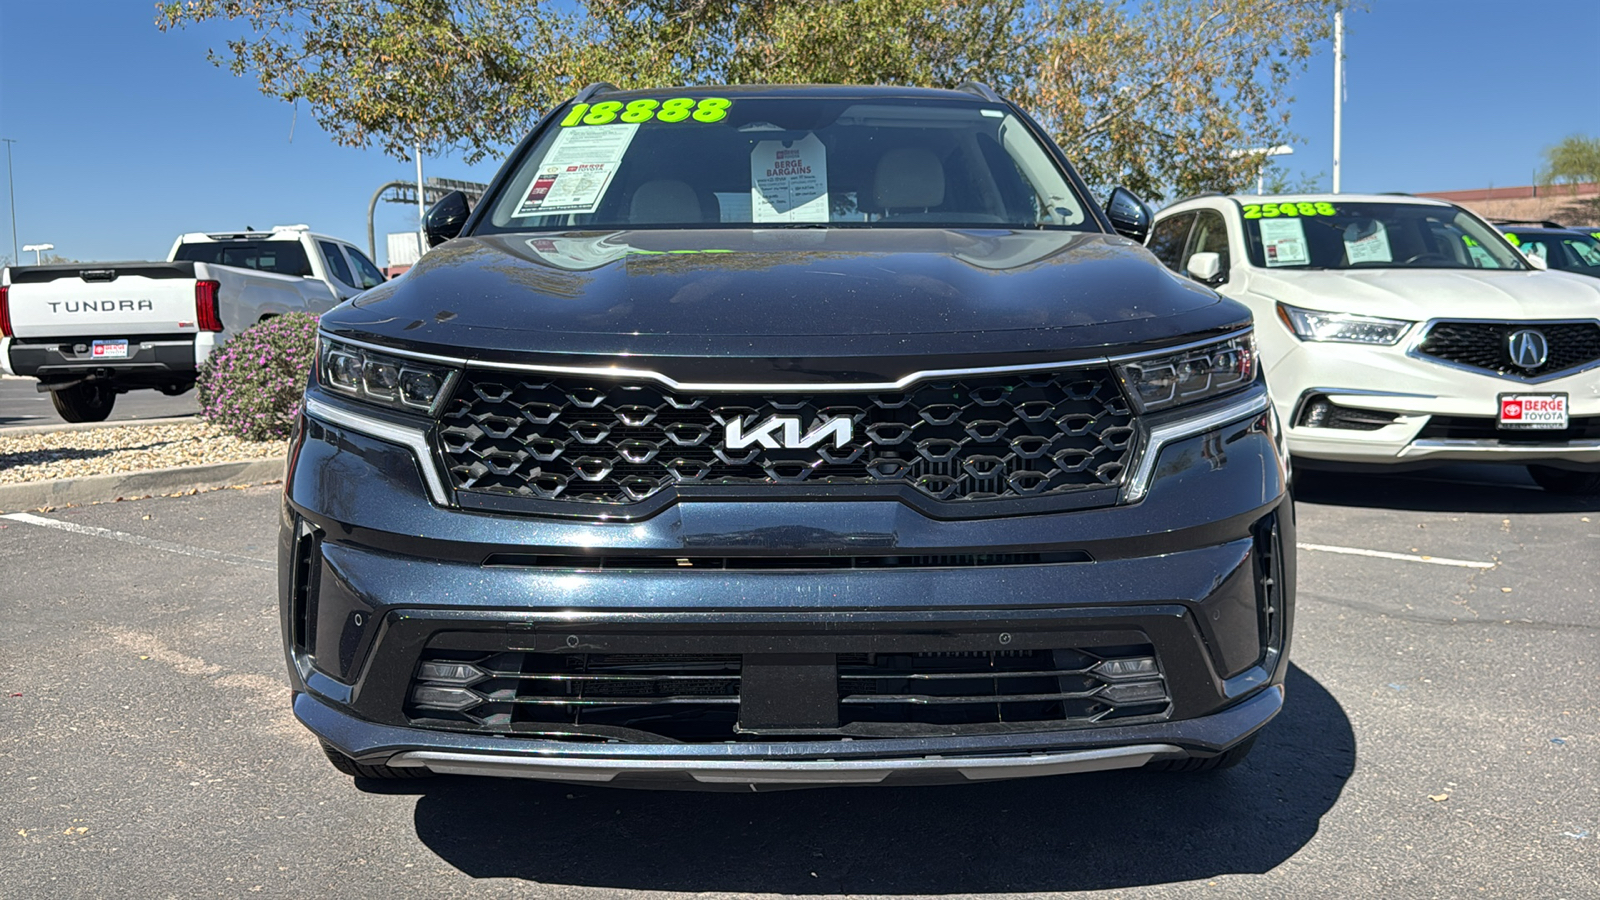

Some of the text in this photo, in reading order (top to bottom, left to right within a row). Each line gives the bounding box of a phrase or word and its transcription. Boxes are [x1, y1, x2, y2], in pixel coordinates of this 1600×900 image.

[560, 98, 732, 127] 18888
[774, 160, 802, 168] BERGE
[766, 166, 811, 176] BARGAINS
[1242, 202, 1337, 219] 25988
[48, 300, 153, 313] TUNDRA
[1524, 400, 1563, 411] BERGE
[1524, 412, 1563, 420] TOYOTA
[725, 415, 852, 448] KIA
